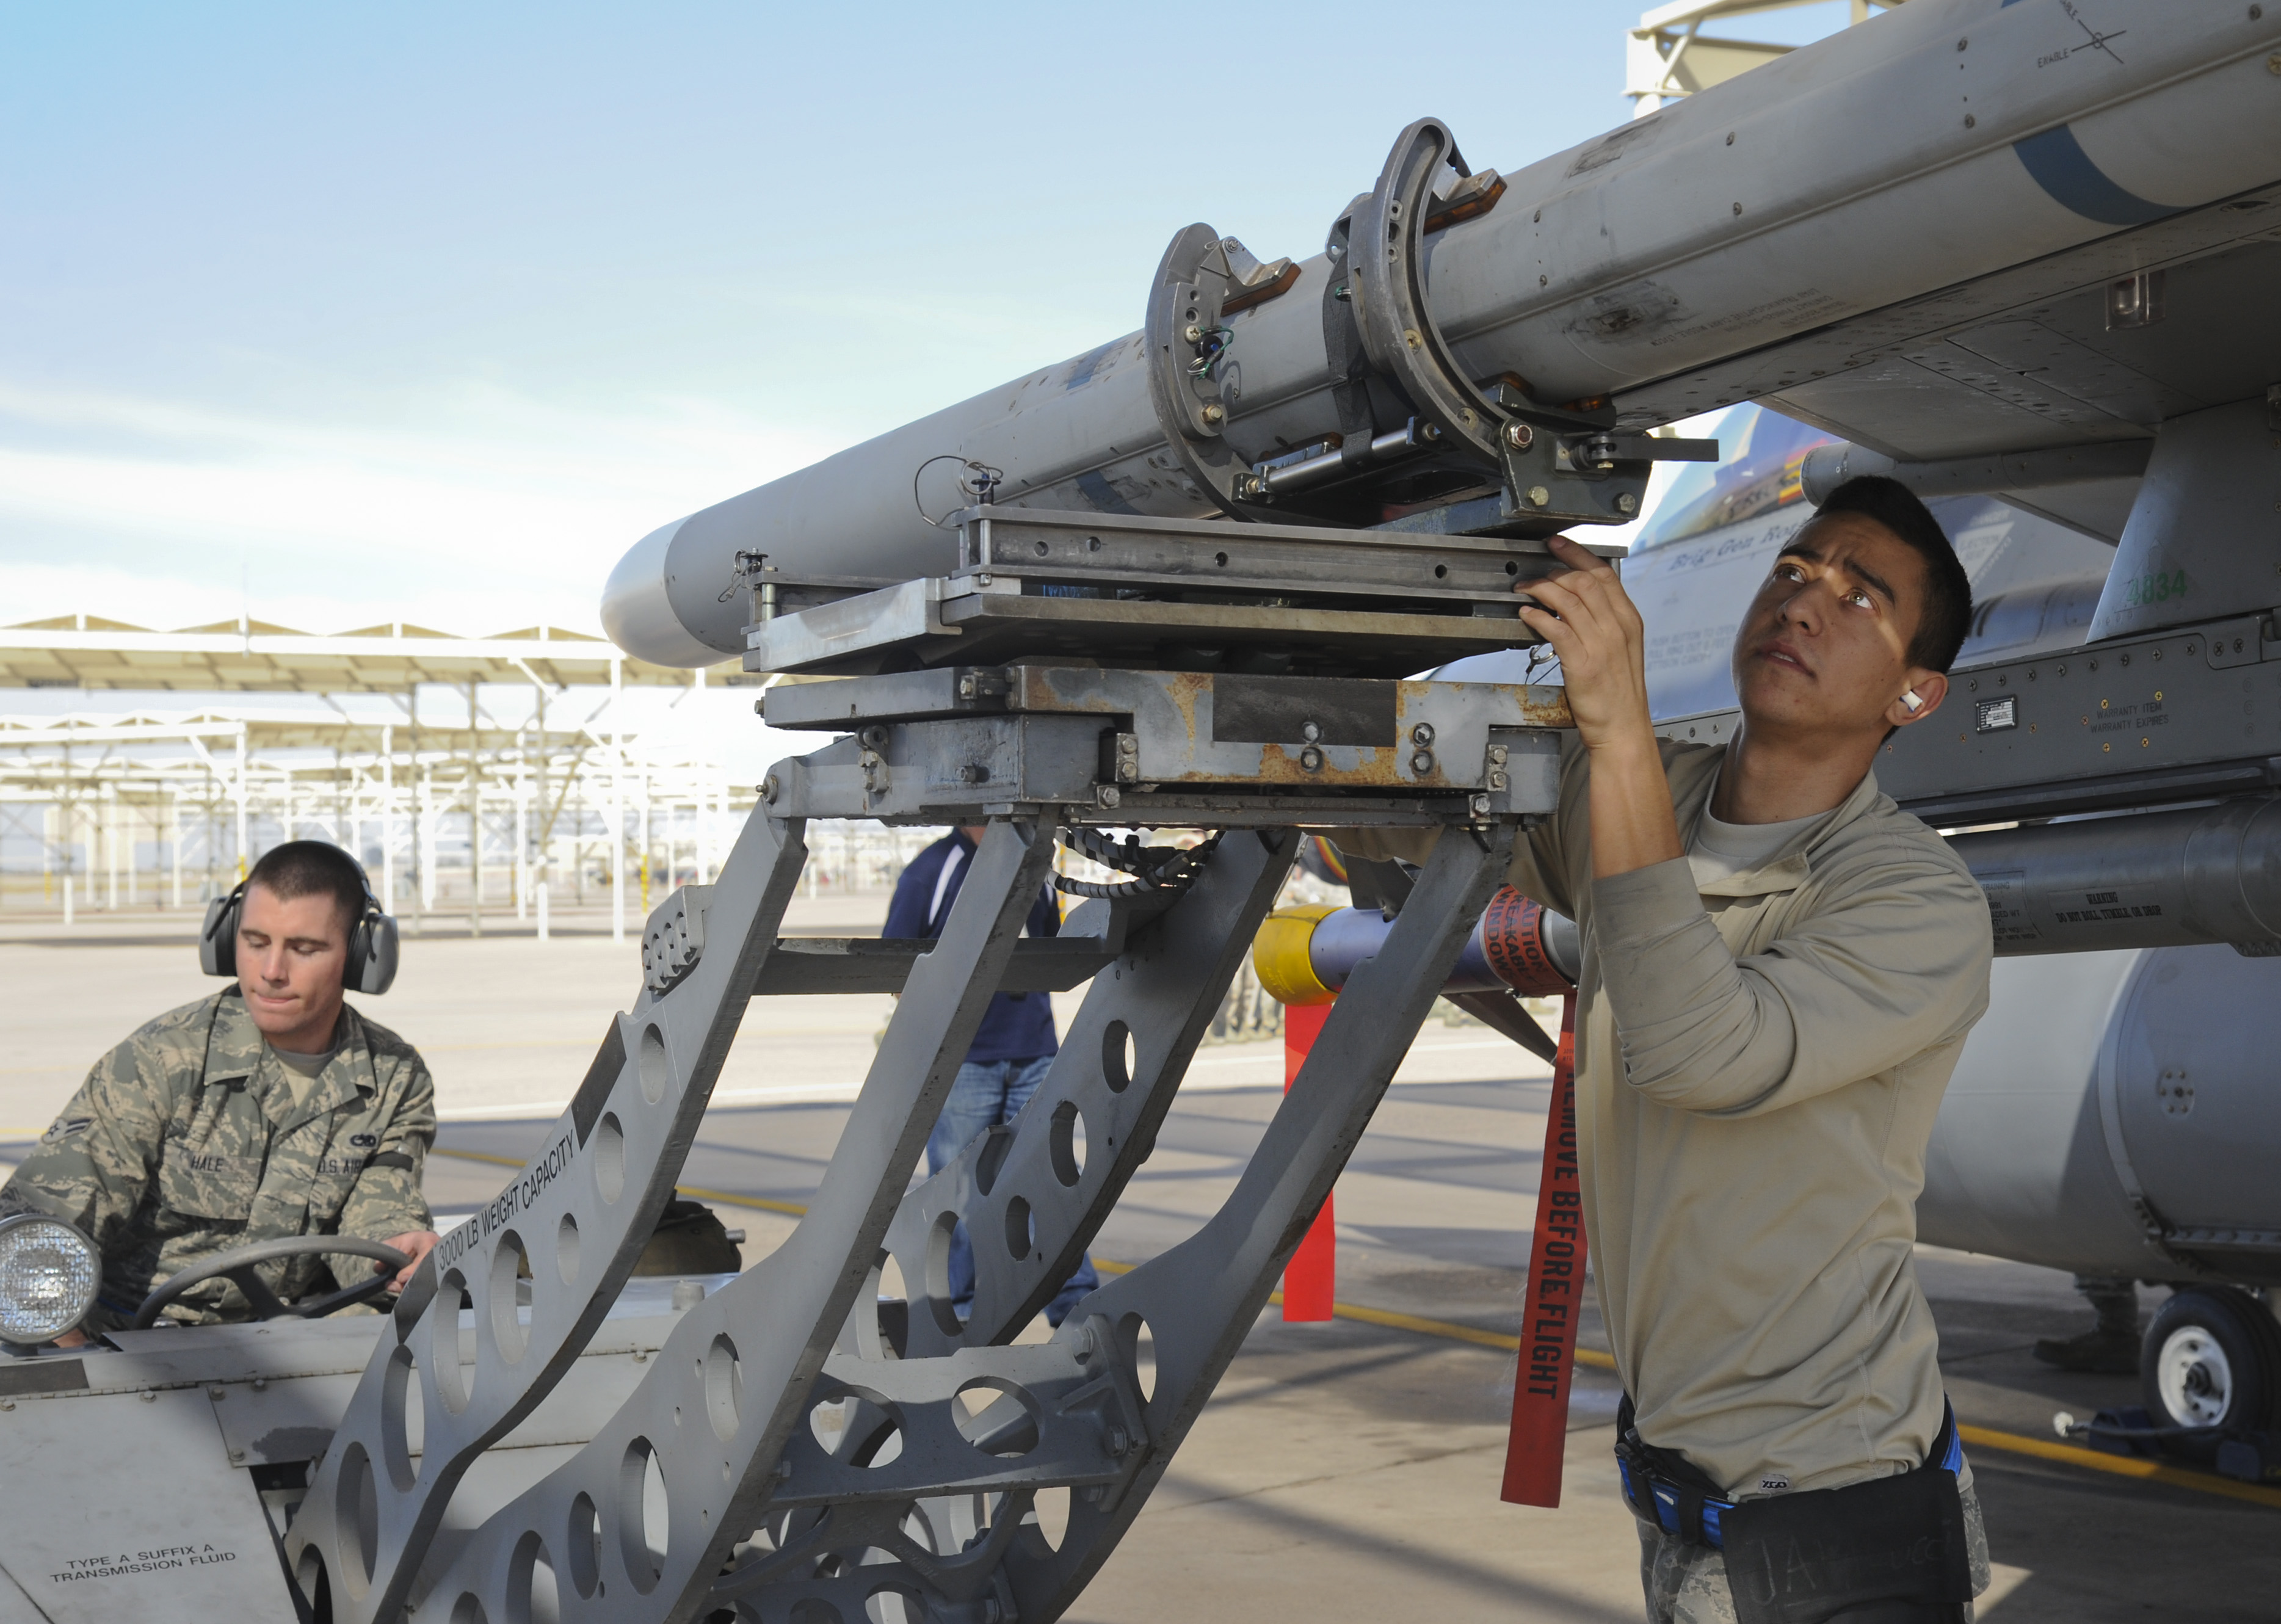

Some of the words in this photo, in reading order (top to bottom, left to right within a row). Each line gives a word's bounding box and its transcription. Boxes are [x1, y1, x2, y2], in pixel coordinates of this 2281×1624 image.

[2037, 48, 2069, 68] ENABLE
[2127, 569, 2188, 606] 4834
[2096, 705, 2138, 720] WARRANTY
[2143, 702, 2162, 714] ITEM
[2090, 720, 2131, 733] WARRANTY
[2136, 714, 2169, 728] EXPIRES
[2086, 891, 2119, 905] WARNING
[2055, 912, 2067, 923] DO
[2067, 911, 2082, 923] NOT
[2131, 906, 2143, 918] OR
[2142, 905, 2163, 916] DROP
[1521, 899, 1549, 973] AUTION
[190, 1155, 224, 1173] HALE
[438, 1230, 464, 1271] 3000
[466, 1219, 479, 1250] LB
[481, 1184, 519, 1238] WEIGHT
[521, 1128, 574, 1210] CAPACITY
[1539, 1191, 1582, 1295] BEFORE
[1527, 1302, 1568, 1401] FLIGHT
[1762, 1480, 1787, 1489] XGO
[50, 1559, 183, 1584] TRANSMISSION
[189, 1551, 236, 1566] FLUID
[65, 1556, 111, 1570] TYPE
[119, 1554, 131, 1563] A
[137, 1545, 195, 1561] SUFFIX
[203, 1543, 214, 1553] A
